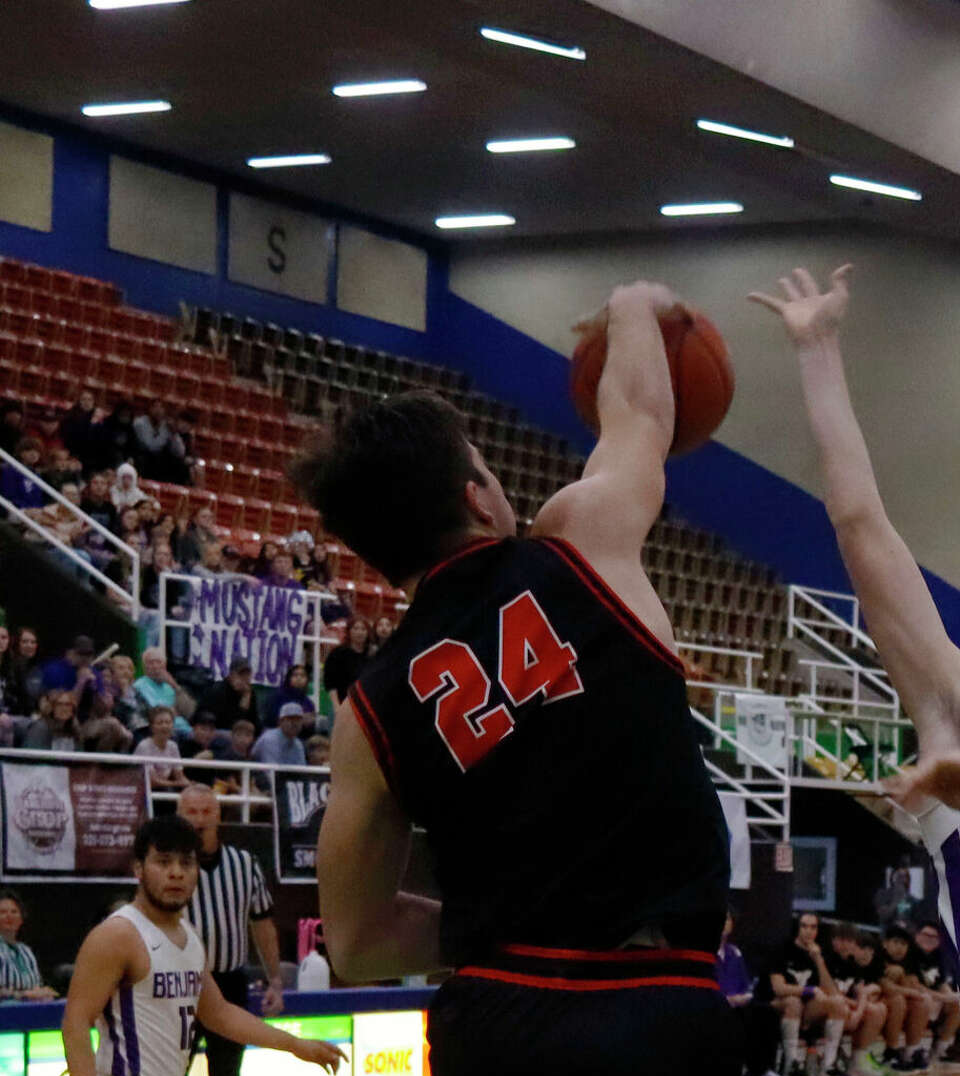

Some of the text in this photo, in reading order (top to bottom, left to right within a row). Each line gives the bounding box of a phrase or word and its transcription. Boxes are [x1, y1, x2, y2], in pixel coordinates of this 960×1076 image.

[267, 226, 287, 274] S
[408, 589, 585, 773] 24
[364, 1048, 413, 1074] SONIC
